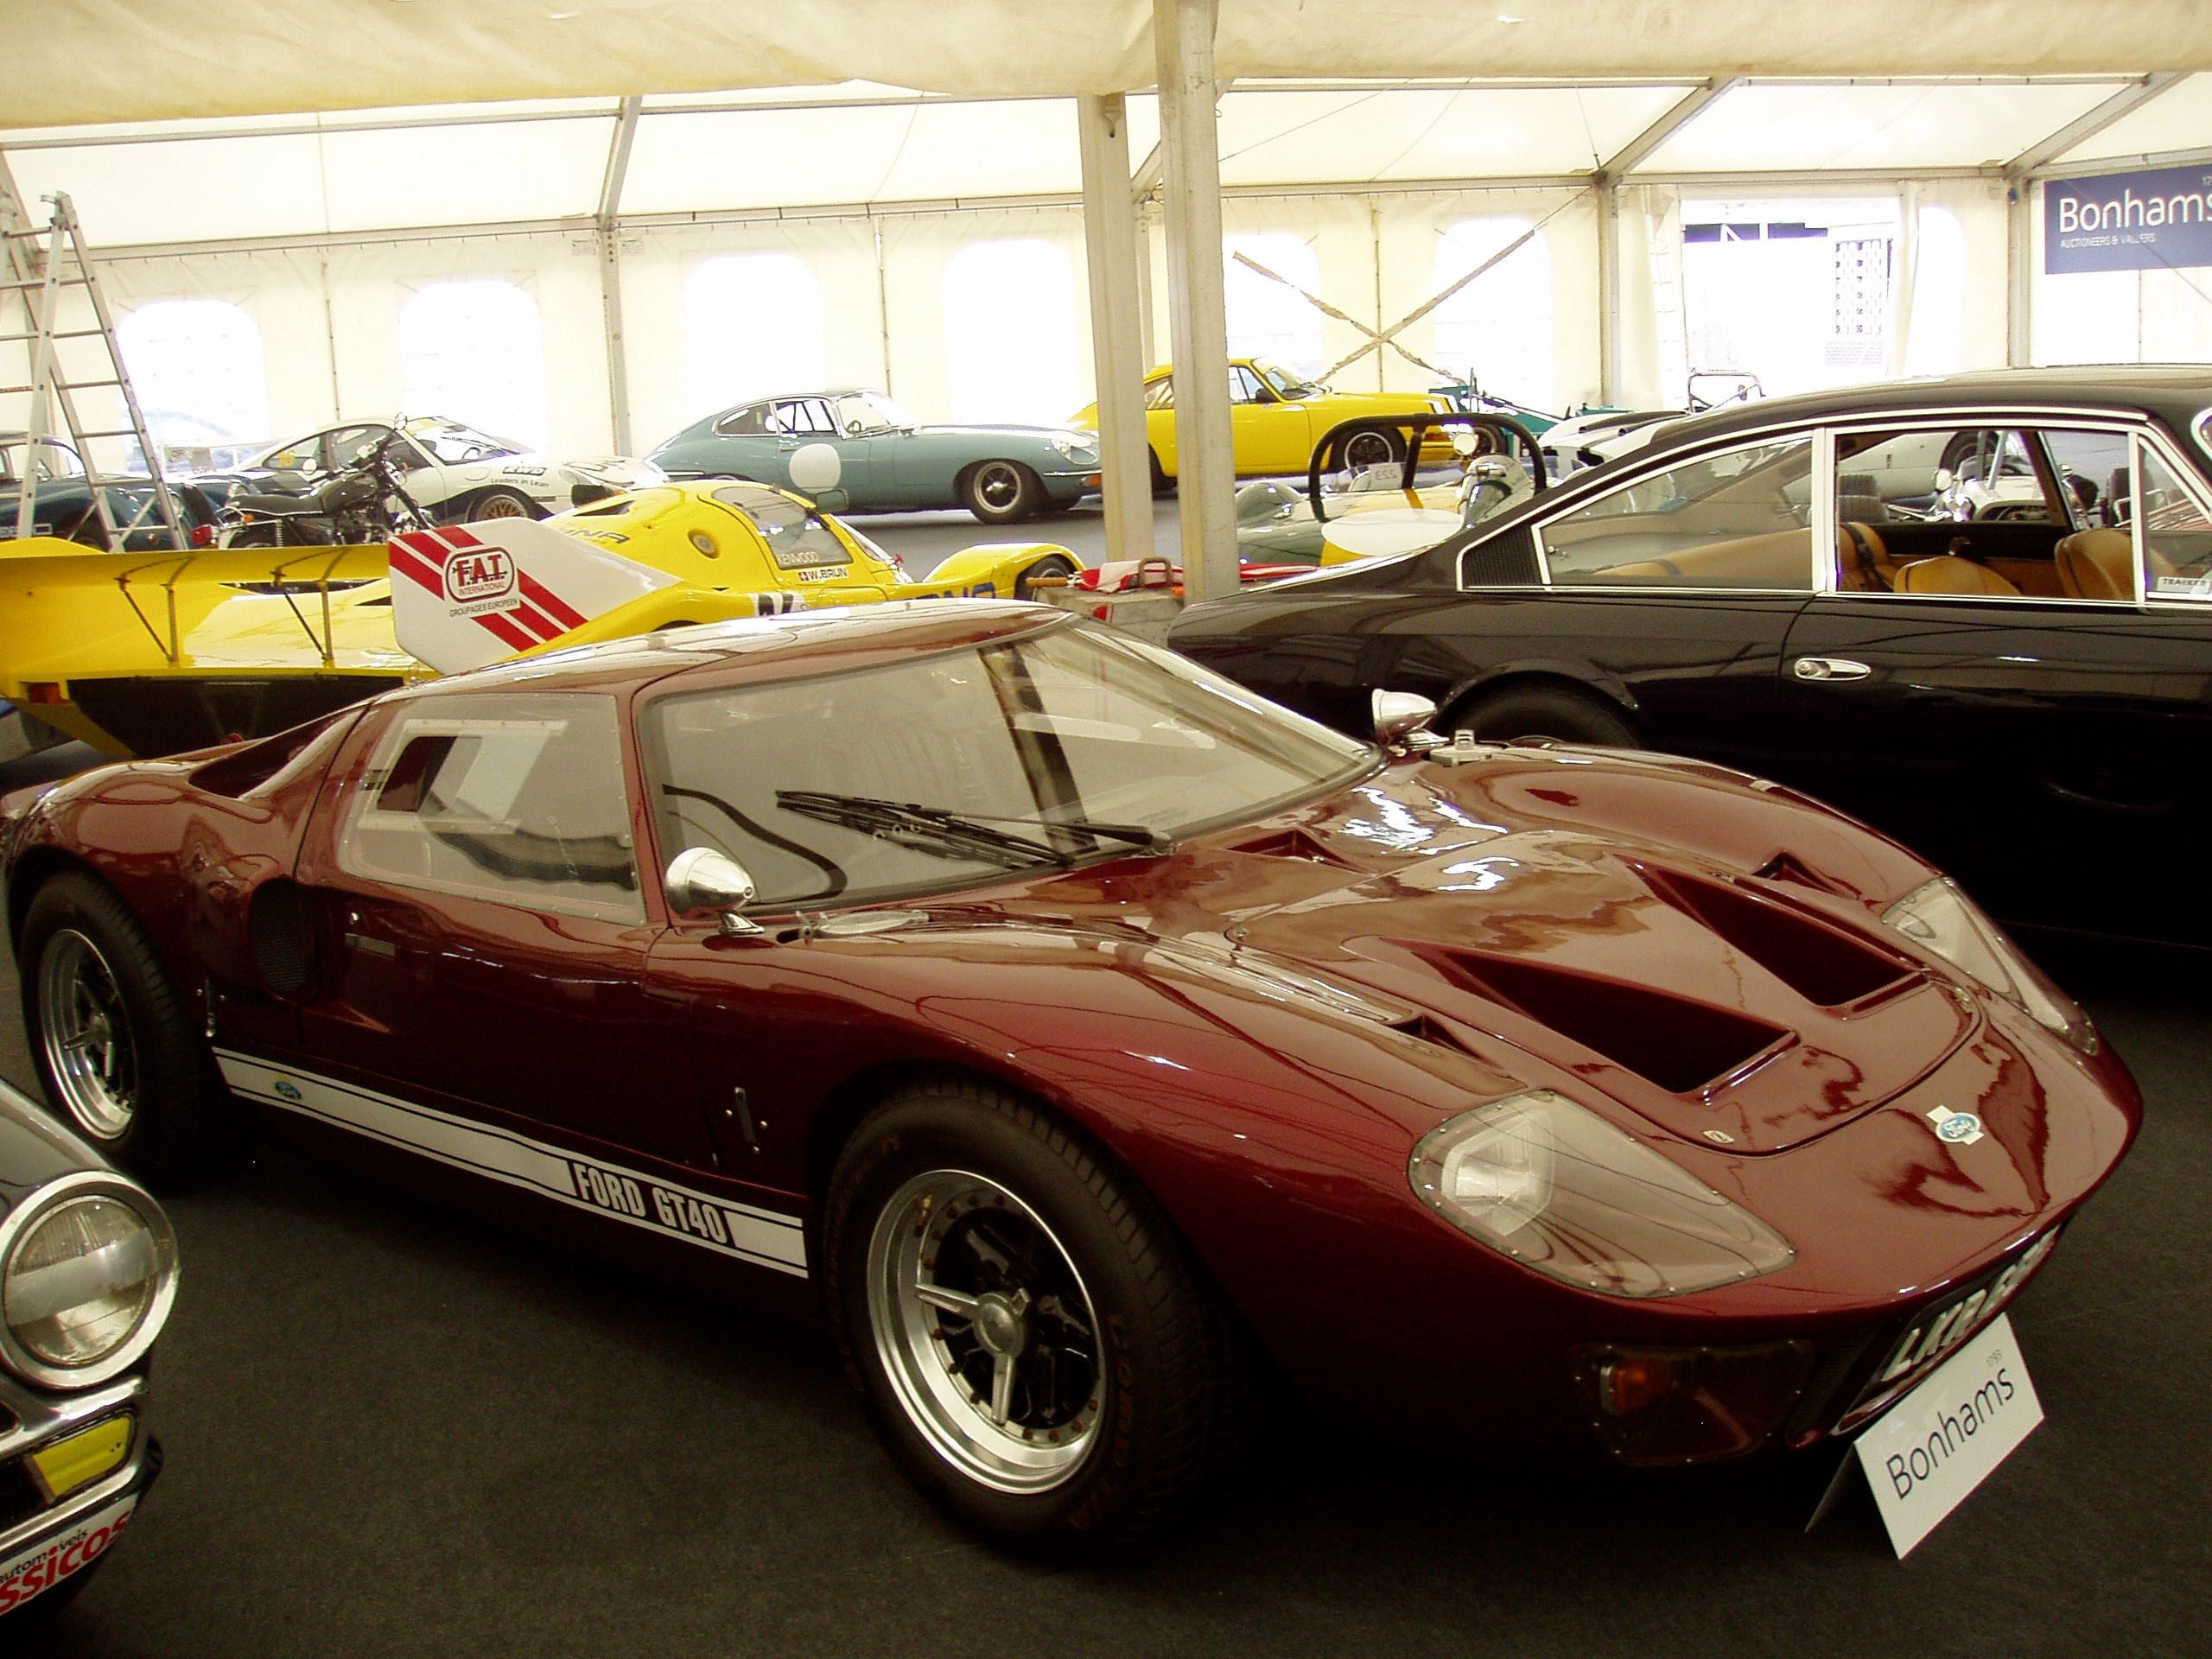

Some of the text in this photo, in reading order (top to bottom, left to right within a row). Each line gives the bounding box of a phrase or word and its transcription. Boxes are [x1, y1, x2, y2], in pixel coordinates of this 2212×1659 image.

[573, 1163, 728, 1244] FORD GT40
[1886, 1368, 2014, 1500] Bonhams
[0, 1529, 88, 1584] automveis
